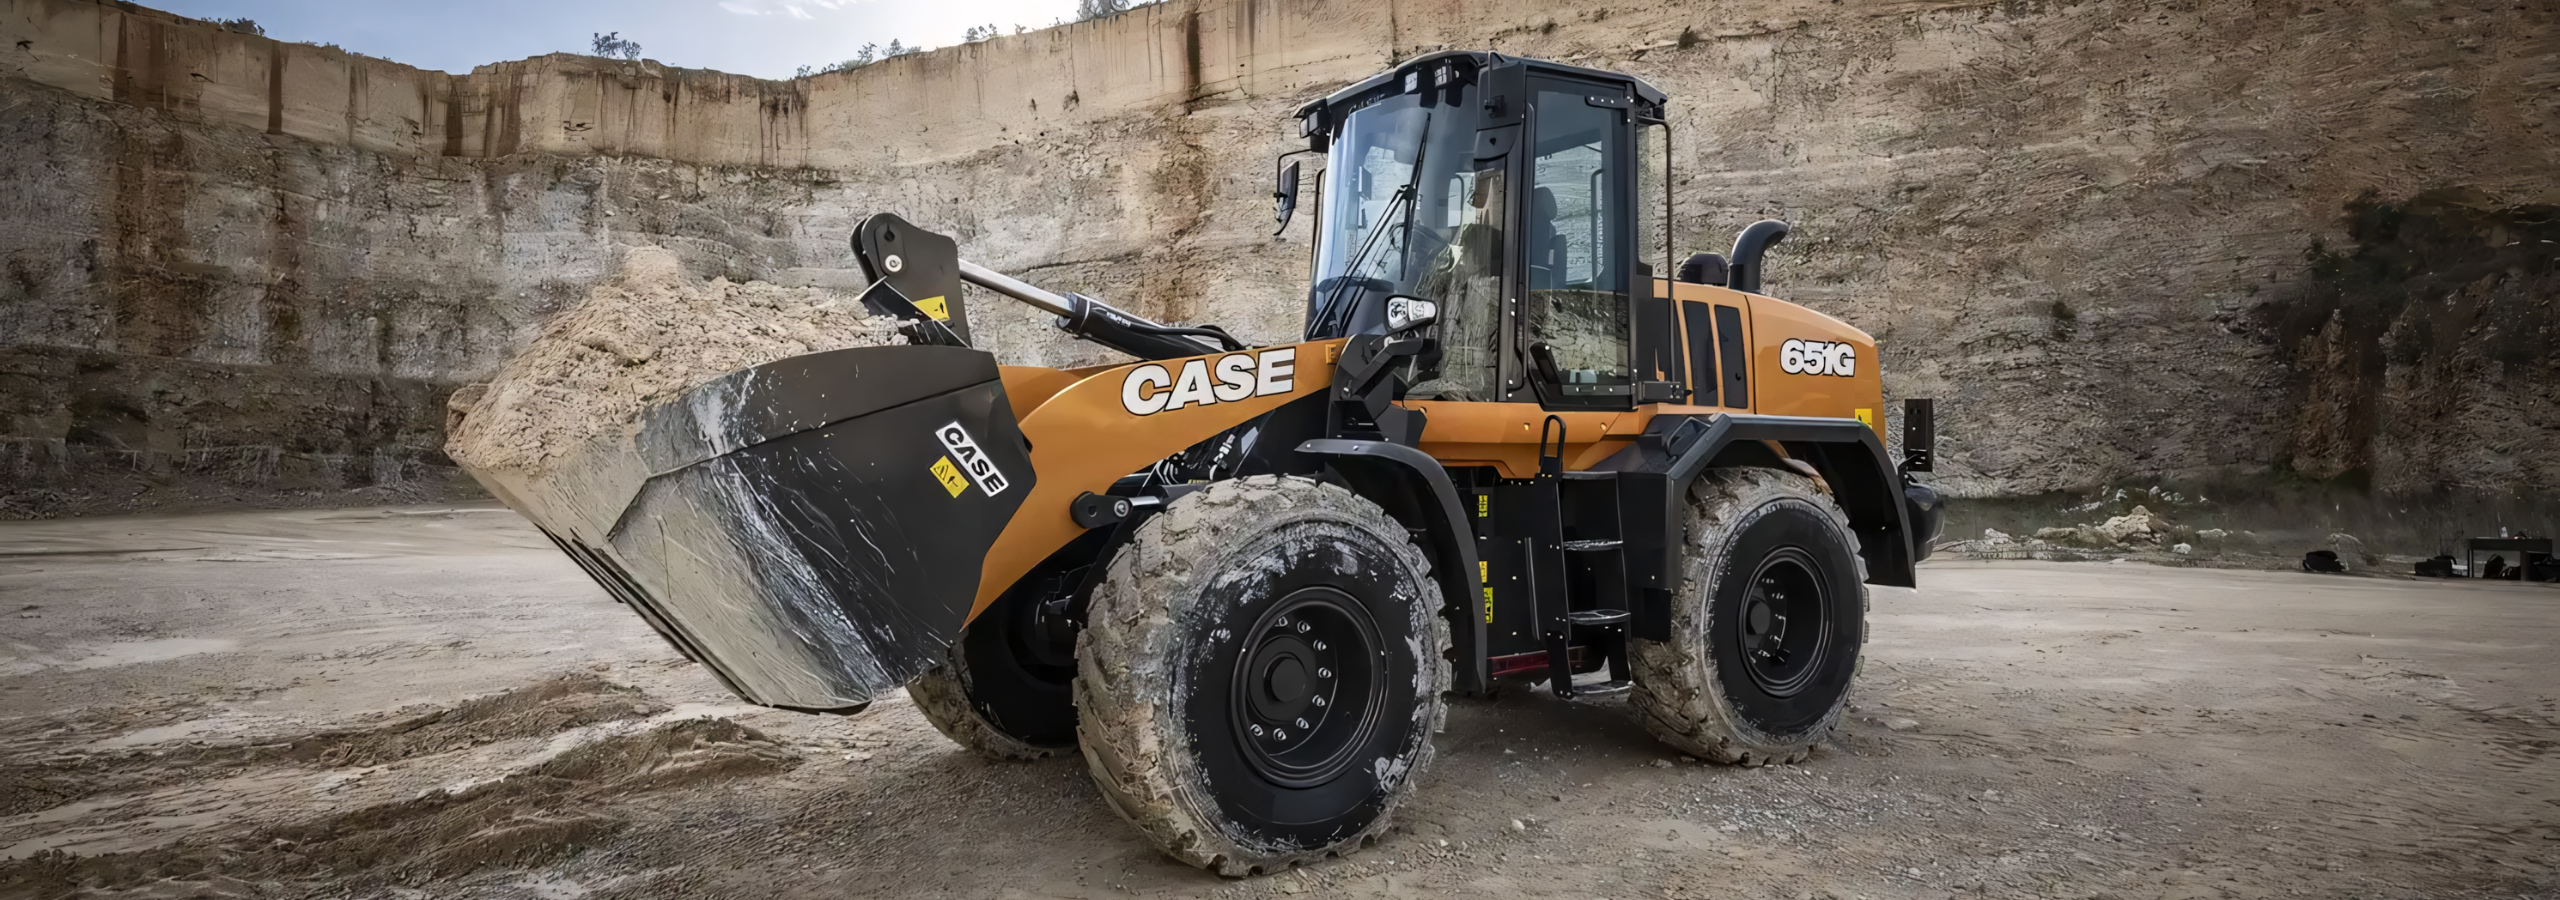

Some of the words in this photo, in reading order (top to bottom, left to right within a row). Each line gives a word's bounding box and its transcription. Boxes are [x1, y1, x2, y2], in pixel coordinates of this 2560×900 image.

[1121, 347, 1296, 416] CASE
[1780, 338, 1855, 377] 651G
[944, 427, 1005, 493] CASE
